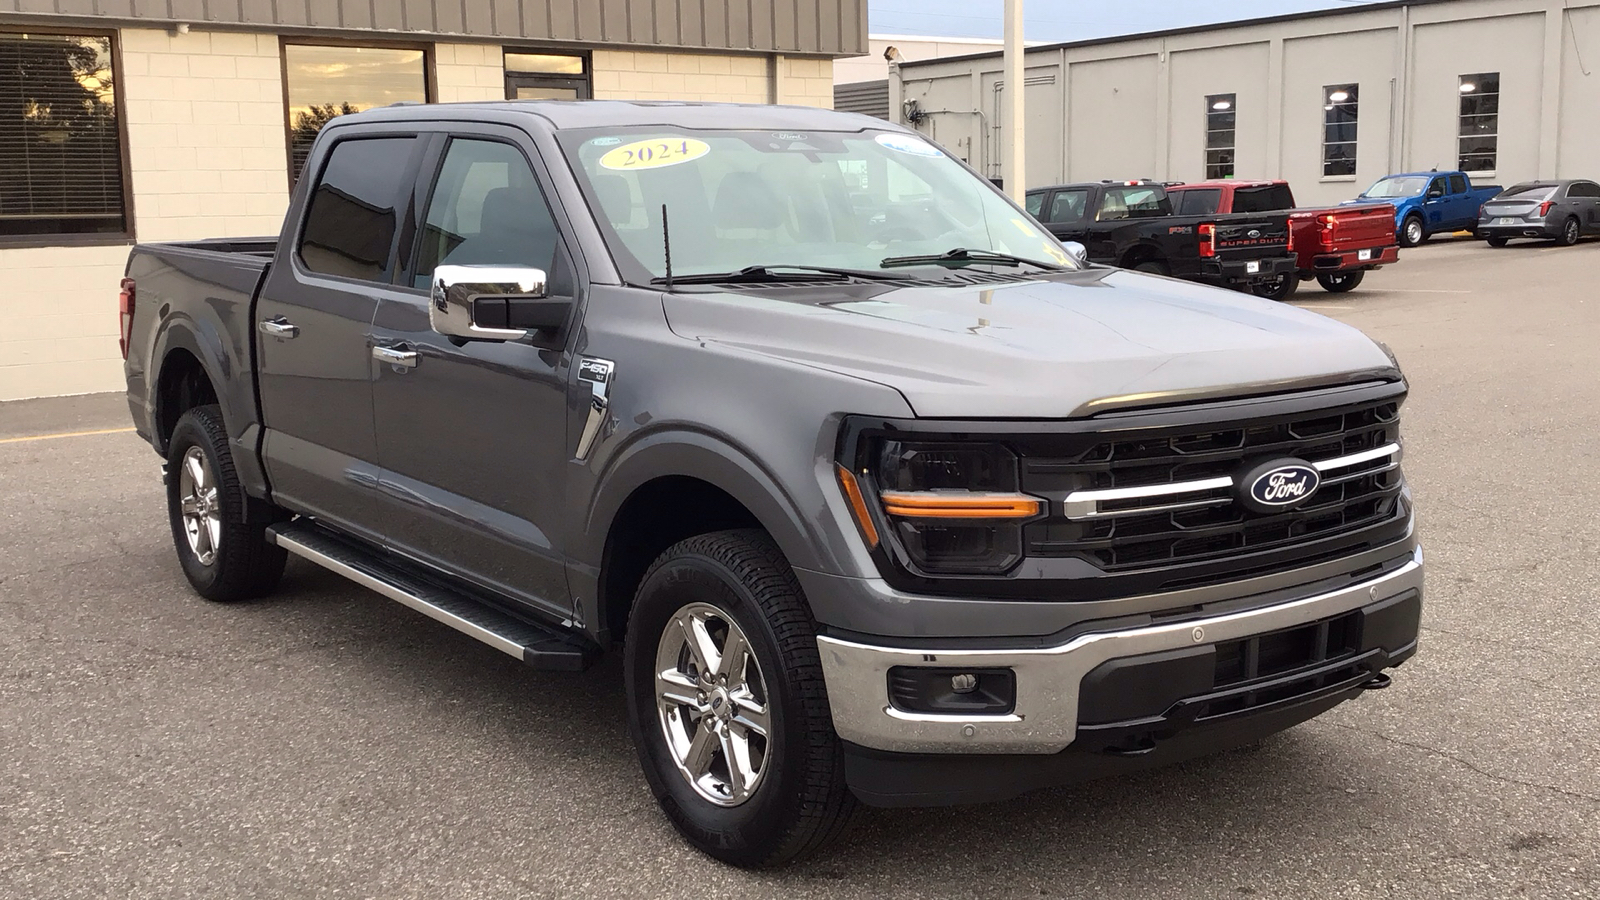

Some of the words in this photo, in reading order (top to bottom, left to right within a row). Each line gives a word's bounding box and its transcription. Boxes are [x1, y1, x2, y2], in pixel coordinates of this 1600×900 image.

[621, 140, 689, 166] 2024
[1168, 226, 1193, 235] FX4
[1219, 239, 1258, 247] SUPER
[1264, 471, 1307, 500] Ford
